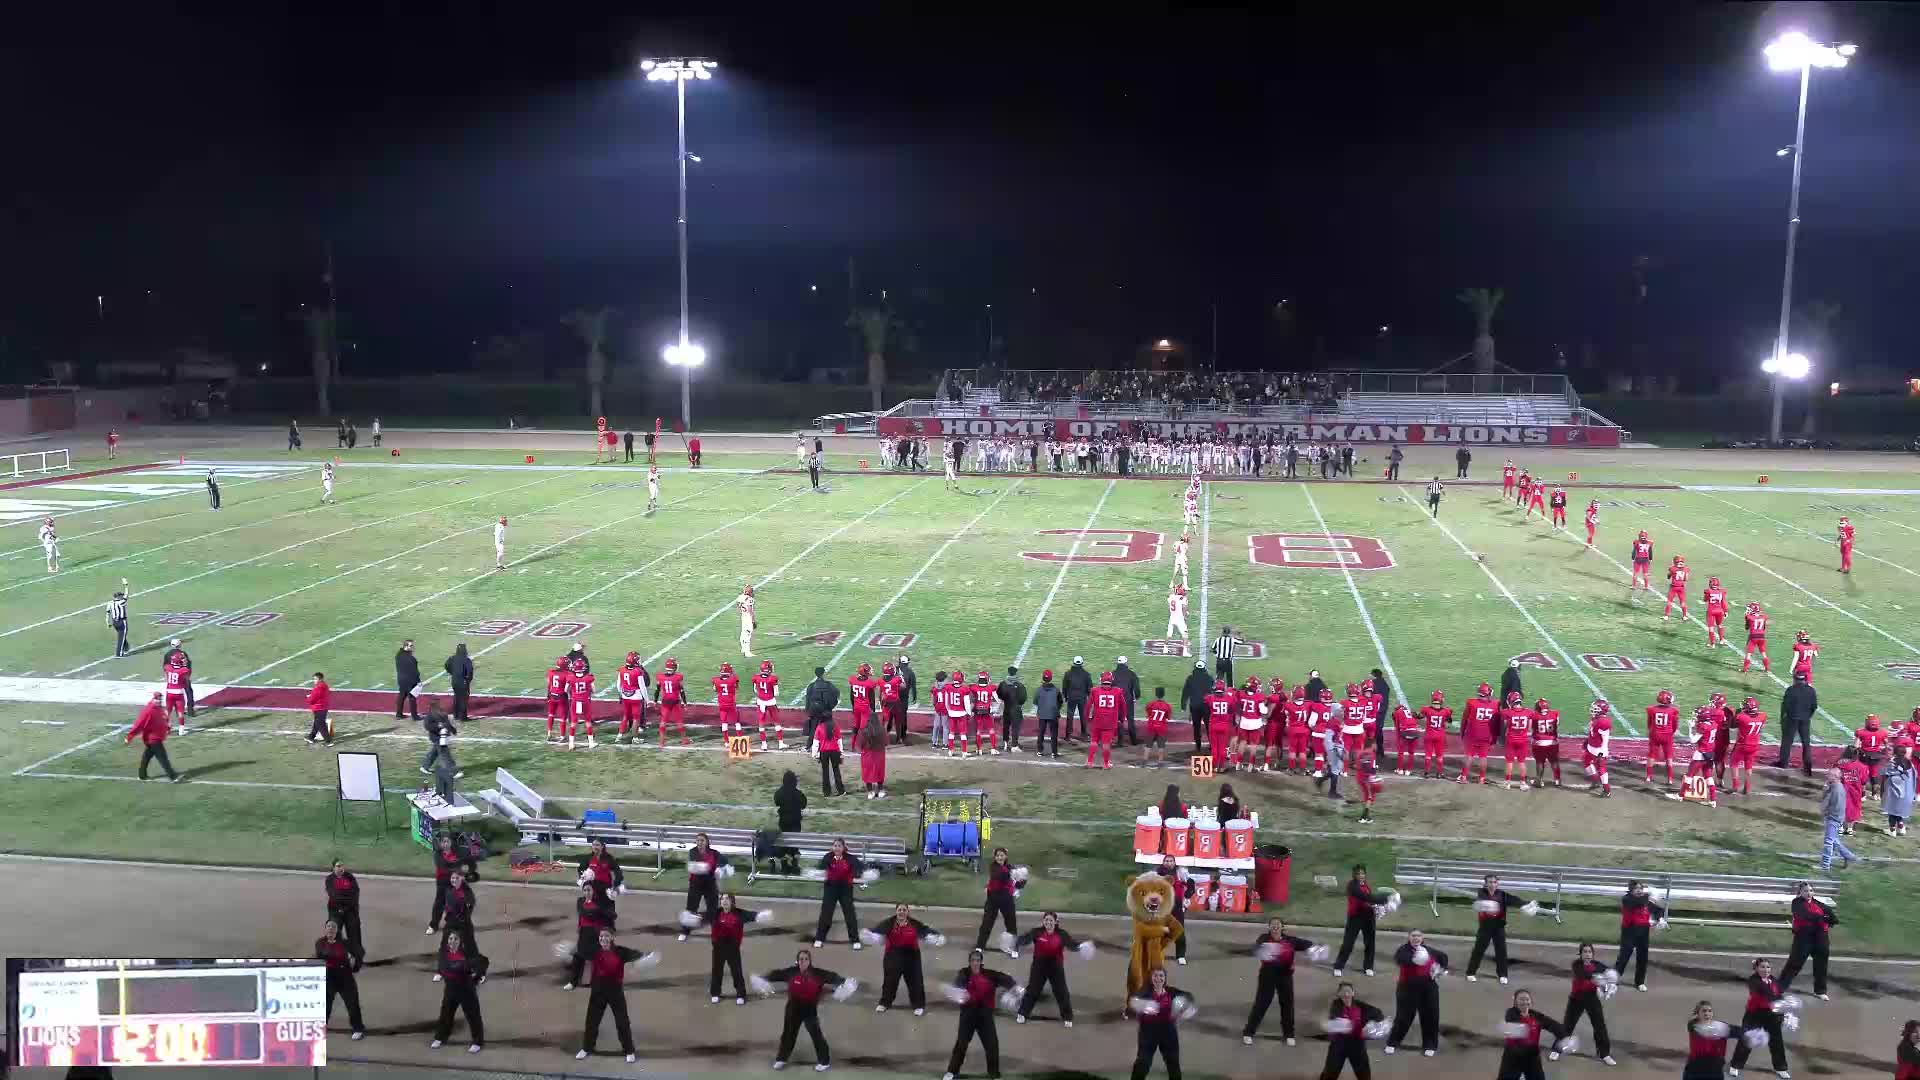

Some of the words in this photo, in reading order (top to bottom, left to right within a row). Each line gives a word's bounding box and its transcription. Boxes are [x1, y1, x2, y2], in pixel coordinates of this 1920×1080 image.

[1422, 426, 1548, 442] LIONS
[1753, 619, 1764, 629] 17
[552, 675, 560, 687] 6
[623, 672, 631, 686] 9
[574, 682, 586, 694] 12
[664, 680, 674, 694] 11
[721, 684, 729, 696] 3
[759, 682, 768, 694] 4
[852, 684, 866, 698] 54
[950, 692, 960, 706] 16
[1098, 695, 1115, 707] 63
[1212, 701, 1228, 715] 58
[1241, 699, 1255, 713] 73
[1151, 710, 1165, 721] 77
[1295, 711, 1308, 722] 71
[1348, 706, 1364, 720] 25
[1476, 707, 1493, 721] 65
[1431, 716, 1443, 728] 51
[1511, 716, 1527, 729] 53
[1655, 713, 1668, 727] 61
[1748, 722, 1762, 735] 77
[731, 738, 748, 756] 40
[1870, 735, 1876, 747] 1
[1193, 757, 1211, 775] 50
[1177, 833, 1185, 843] G
[1202, 835, 1209, 845] G
[1236, 834, 1244, 844] G
[1197, 888, 1205, 897] G
[1224, 889, 1233, 899] G
[28, 1025, 80, 1047] LIONS
